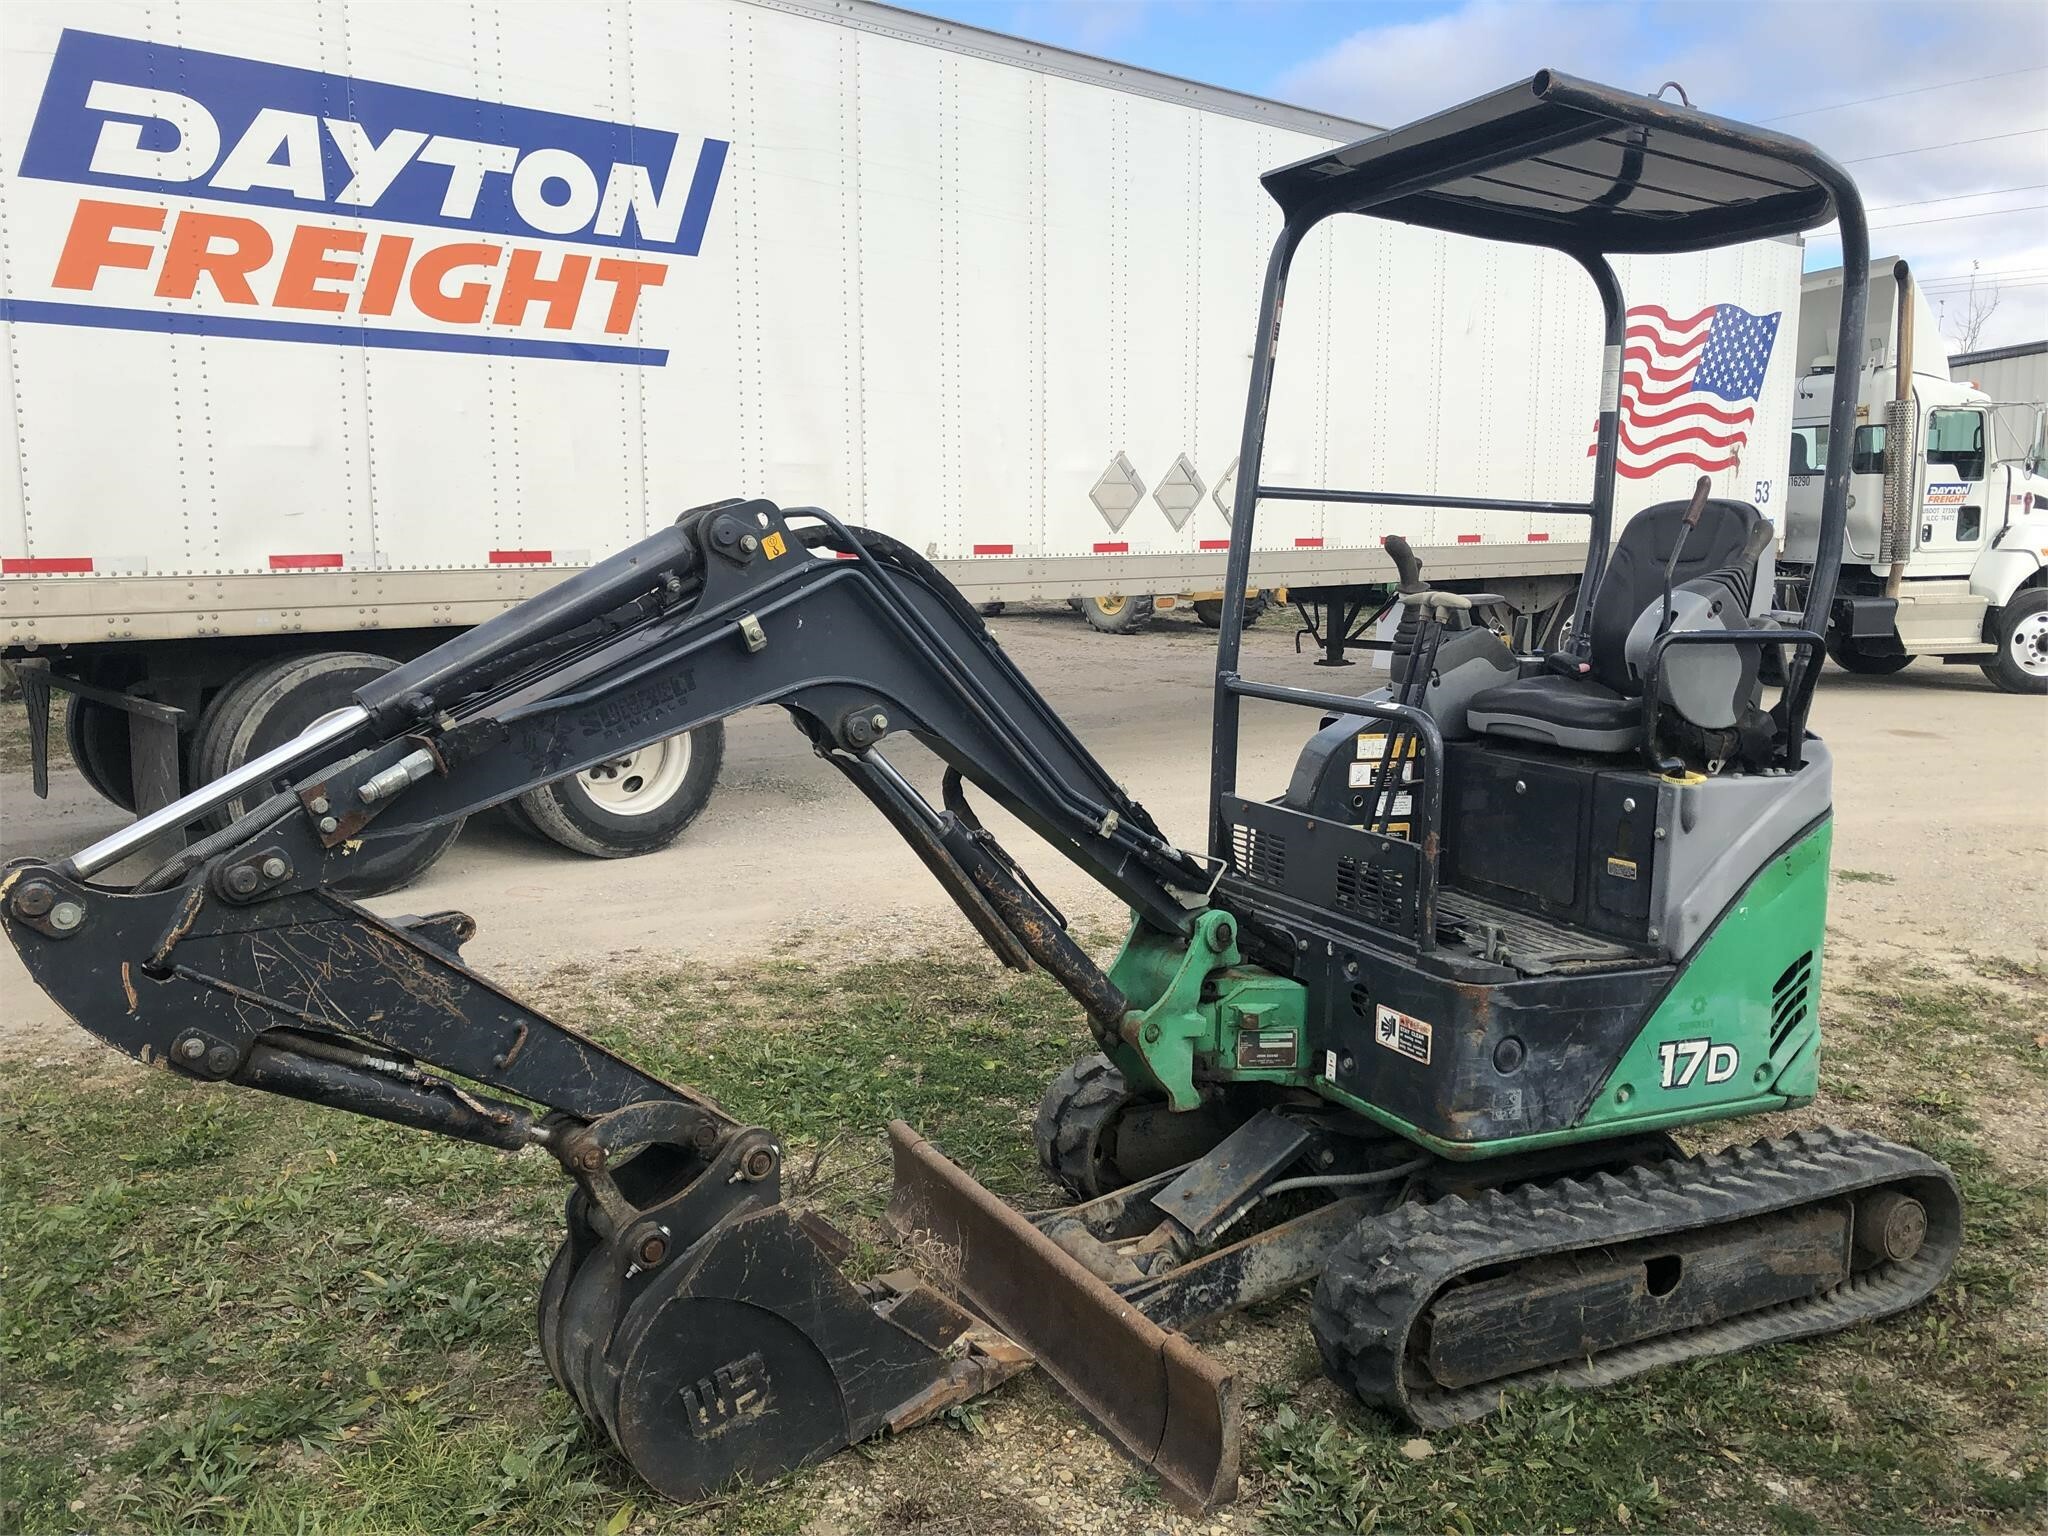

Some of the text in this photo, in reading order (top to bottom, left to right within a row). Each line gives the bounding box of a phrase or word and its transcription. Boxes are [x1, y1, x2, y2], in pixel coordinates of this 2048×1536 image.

[86, 80, 705, 244] DAYTON
[51, 199, 669, 335] FREIGHT
[1788, 476, 1810, 487] 16290
[1929, 484, 1972, 495] DAYTON
[1660, 1037, 1740, 1090] 17D
